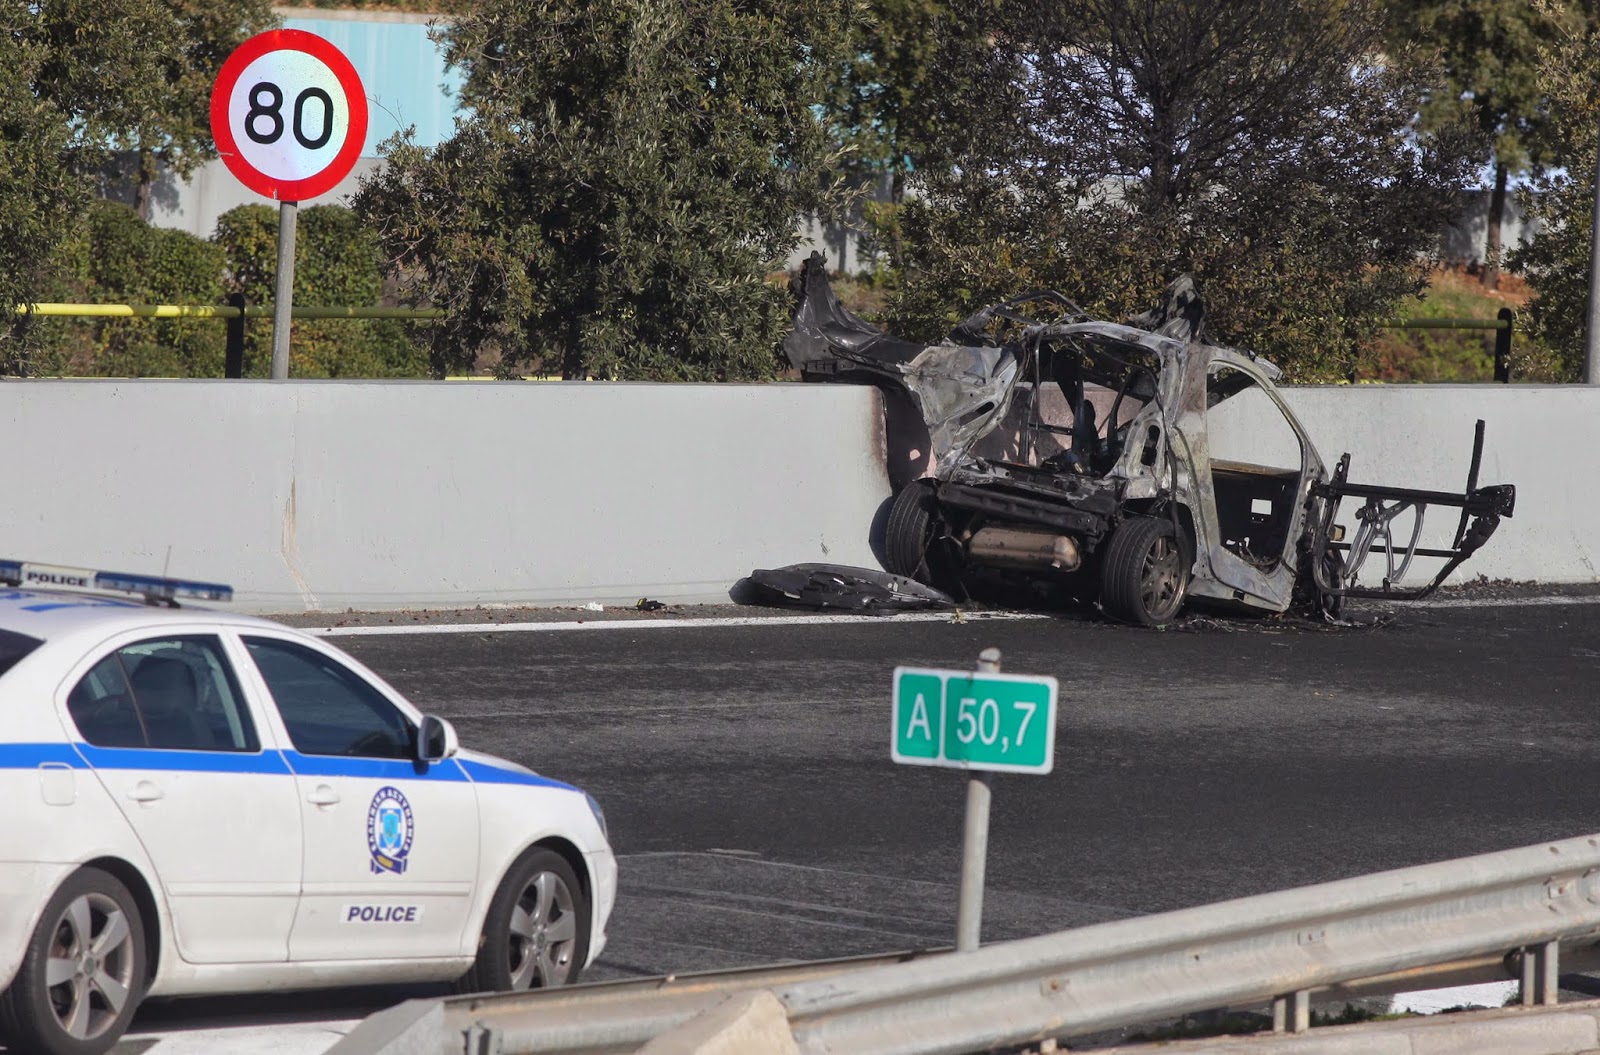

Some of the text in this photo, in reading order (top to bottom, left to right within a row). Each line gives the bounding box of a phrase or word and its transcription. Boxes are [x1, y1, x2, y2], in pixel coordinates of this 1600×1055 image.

[245, 82, 333, 150] 80
[27, 572, 88, 587] POLICE
[906, 692, 1037, 754] A 50,7
[347, 905, 417, 922] POLICE
